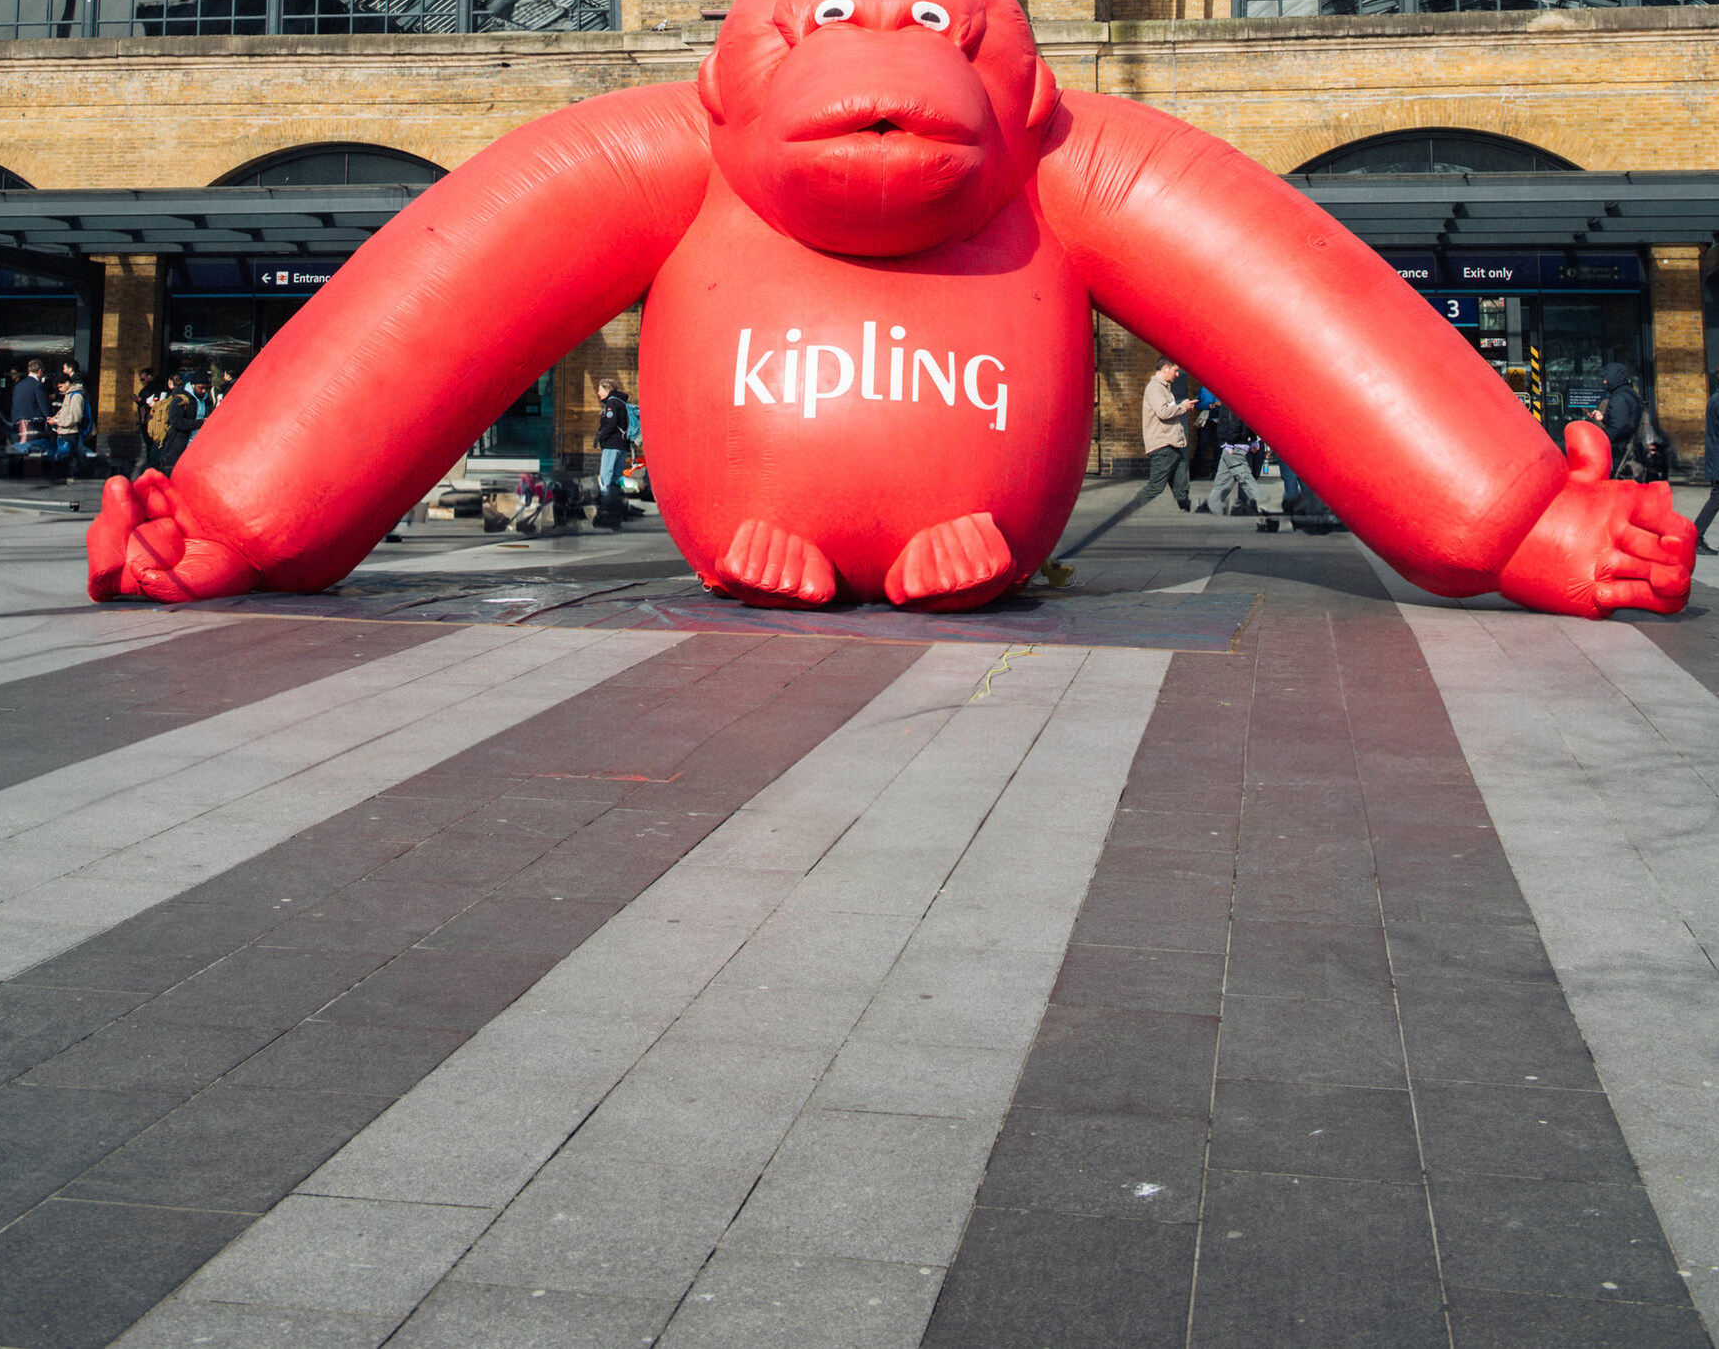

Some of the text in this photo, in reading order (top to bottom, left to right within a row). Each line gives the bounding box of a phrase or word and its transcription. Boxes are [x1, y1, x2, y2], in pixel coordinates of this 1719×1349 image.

[293, 272, 331, 283] Entranc
[1396, 269, 1429, 278] rance
[1463, 267, 1513, 281] Exit only
[1447, 299, 1460, 318] 3
[184, 324, 193, 338] 8
[734, 321, 1008, 431] kipling
